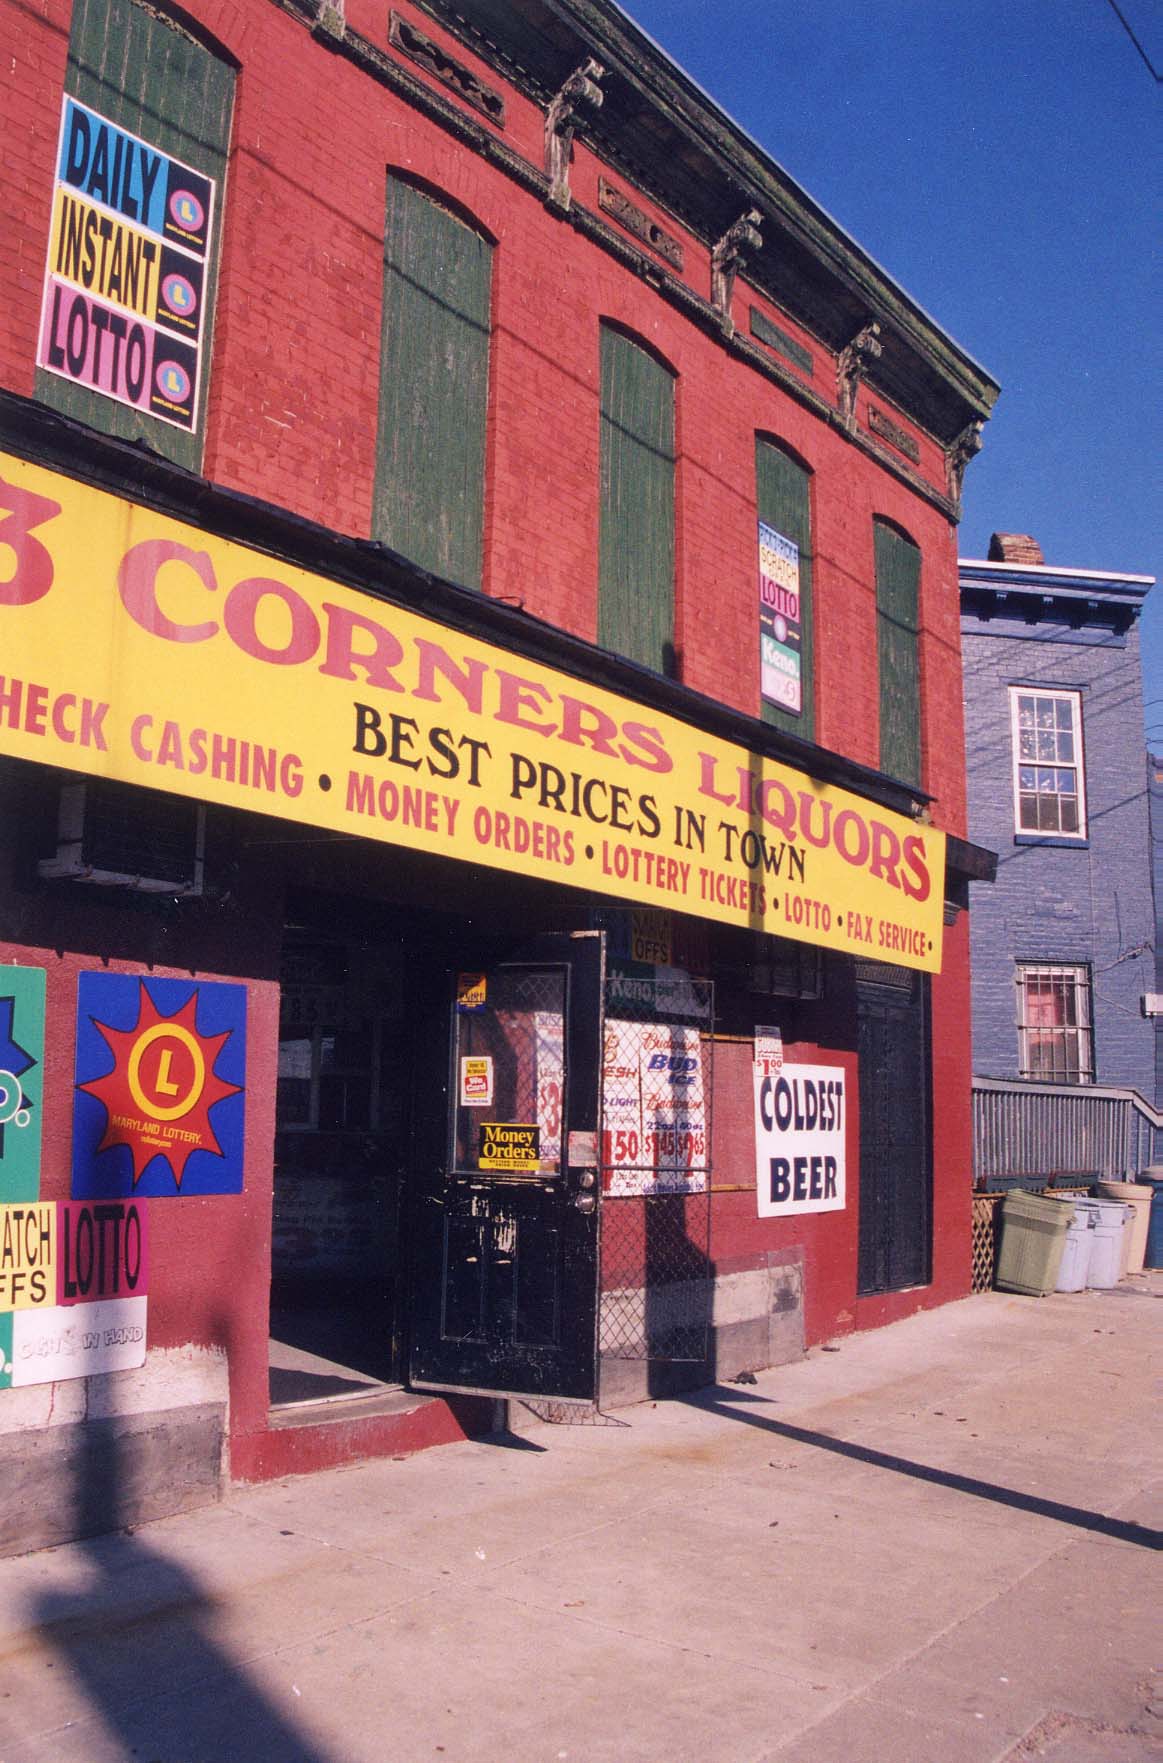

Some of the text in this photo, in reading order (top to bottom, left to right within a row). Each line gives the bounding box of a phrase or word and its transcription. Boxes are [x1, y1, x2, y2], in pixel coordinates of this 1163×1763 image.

[65, 107, 161, 226] DAILY
[56, 194, 156, 316] INSTANT
[48, 285, 146, 403] LOTTO
[763, 576, 797, 618] LOTTO
[117, 538, 673, 773] CORNERS
[698, 752, 931, 902] LIQUORS
[353, 702, 806, 883] BEST PRICES IN TOWN
[129, 714, 304, 798] CASHING
[345, 770, 460, 836] MONEY
[473, 806, 575, 866] ORDERS
[602, 840, 691, 894] LOTTERY
[699, 867, 767, 916] TICKETS
[784, 892, 831, 932] LOTTO
[847, 910, 873, 943] FAX
[878, 920, 926, 957] SERVICE
[155, 1049, 179, 1095] L
[647, 1054, 698, 1073] BUD
[668, 1074, 696, 1085] ICE
[112, 1115, 160, 1134] MARYLAND
[760, 1077, 843, 1132] COLDEST
[483, 1142, 536, 1159] Orders
[485, 1127, 535, 1147] Money
[769, 1155, 837, 1203] BEER
[64, 1204, 140, 1298] LOTTO
[82, 1332, 100, 1350] IN
[103, 1326, 144, 1347] HAND
